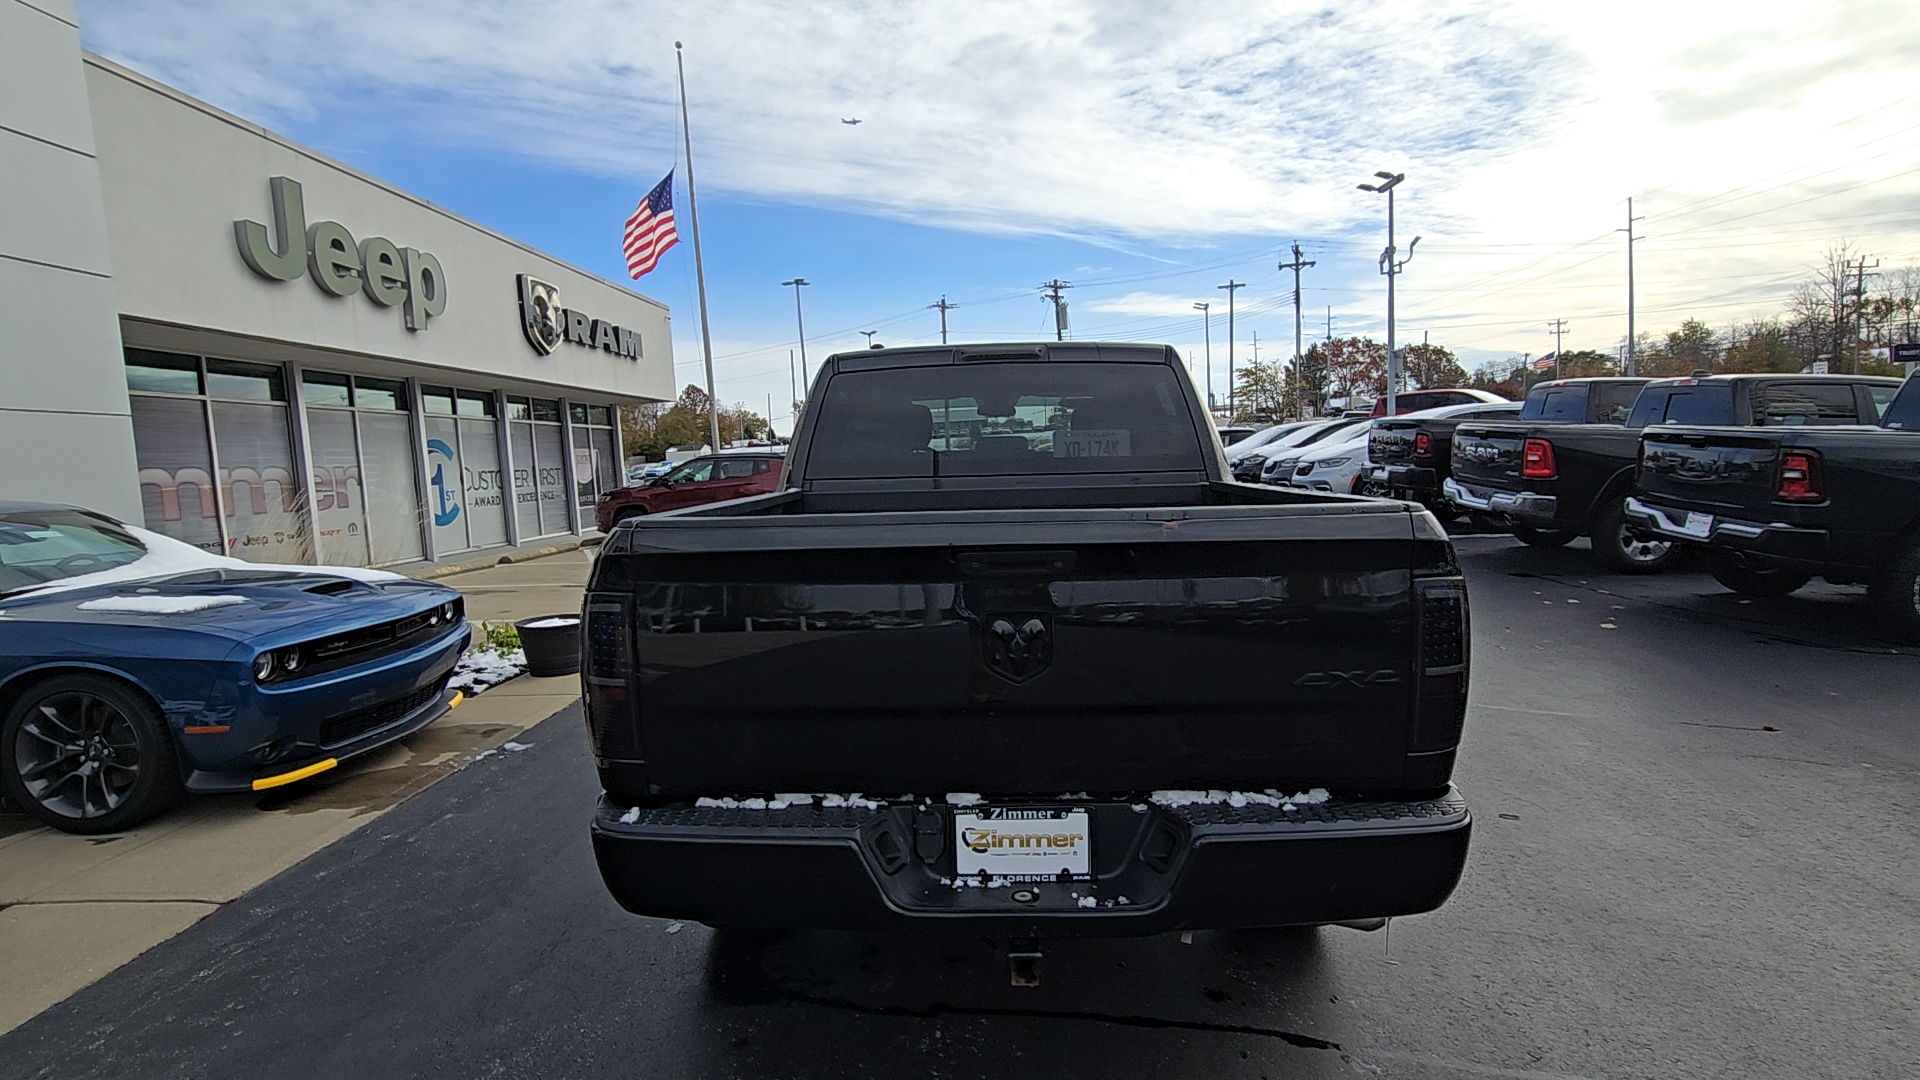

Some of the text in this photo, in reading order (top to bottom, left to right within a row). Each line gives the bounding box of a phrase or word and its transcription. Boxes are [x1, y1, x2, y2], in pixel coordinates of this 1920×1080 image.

[233, 175, 448, 332] Jeep
[563, 308, 644, 360] RAM
[1466, 446, 1498, 458] RAM
[474, 496, 501, 507] AWARD
[990, 807, 1055, 820] Zimmer
[967, 828, 1084, 849] Zimmer
[992, 874, 1058, 883] FLORENCE
